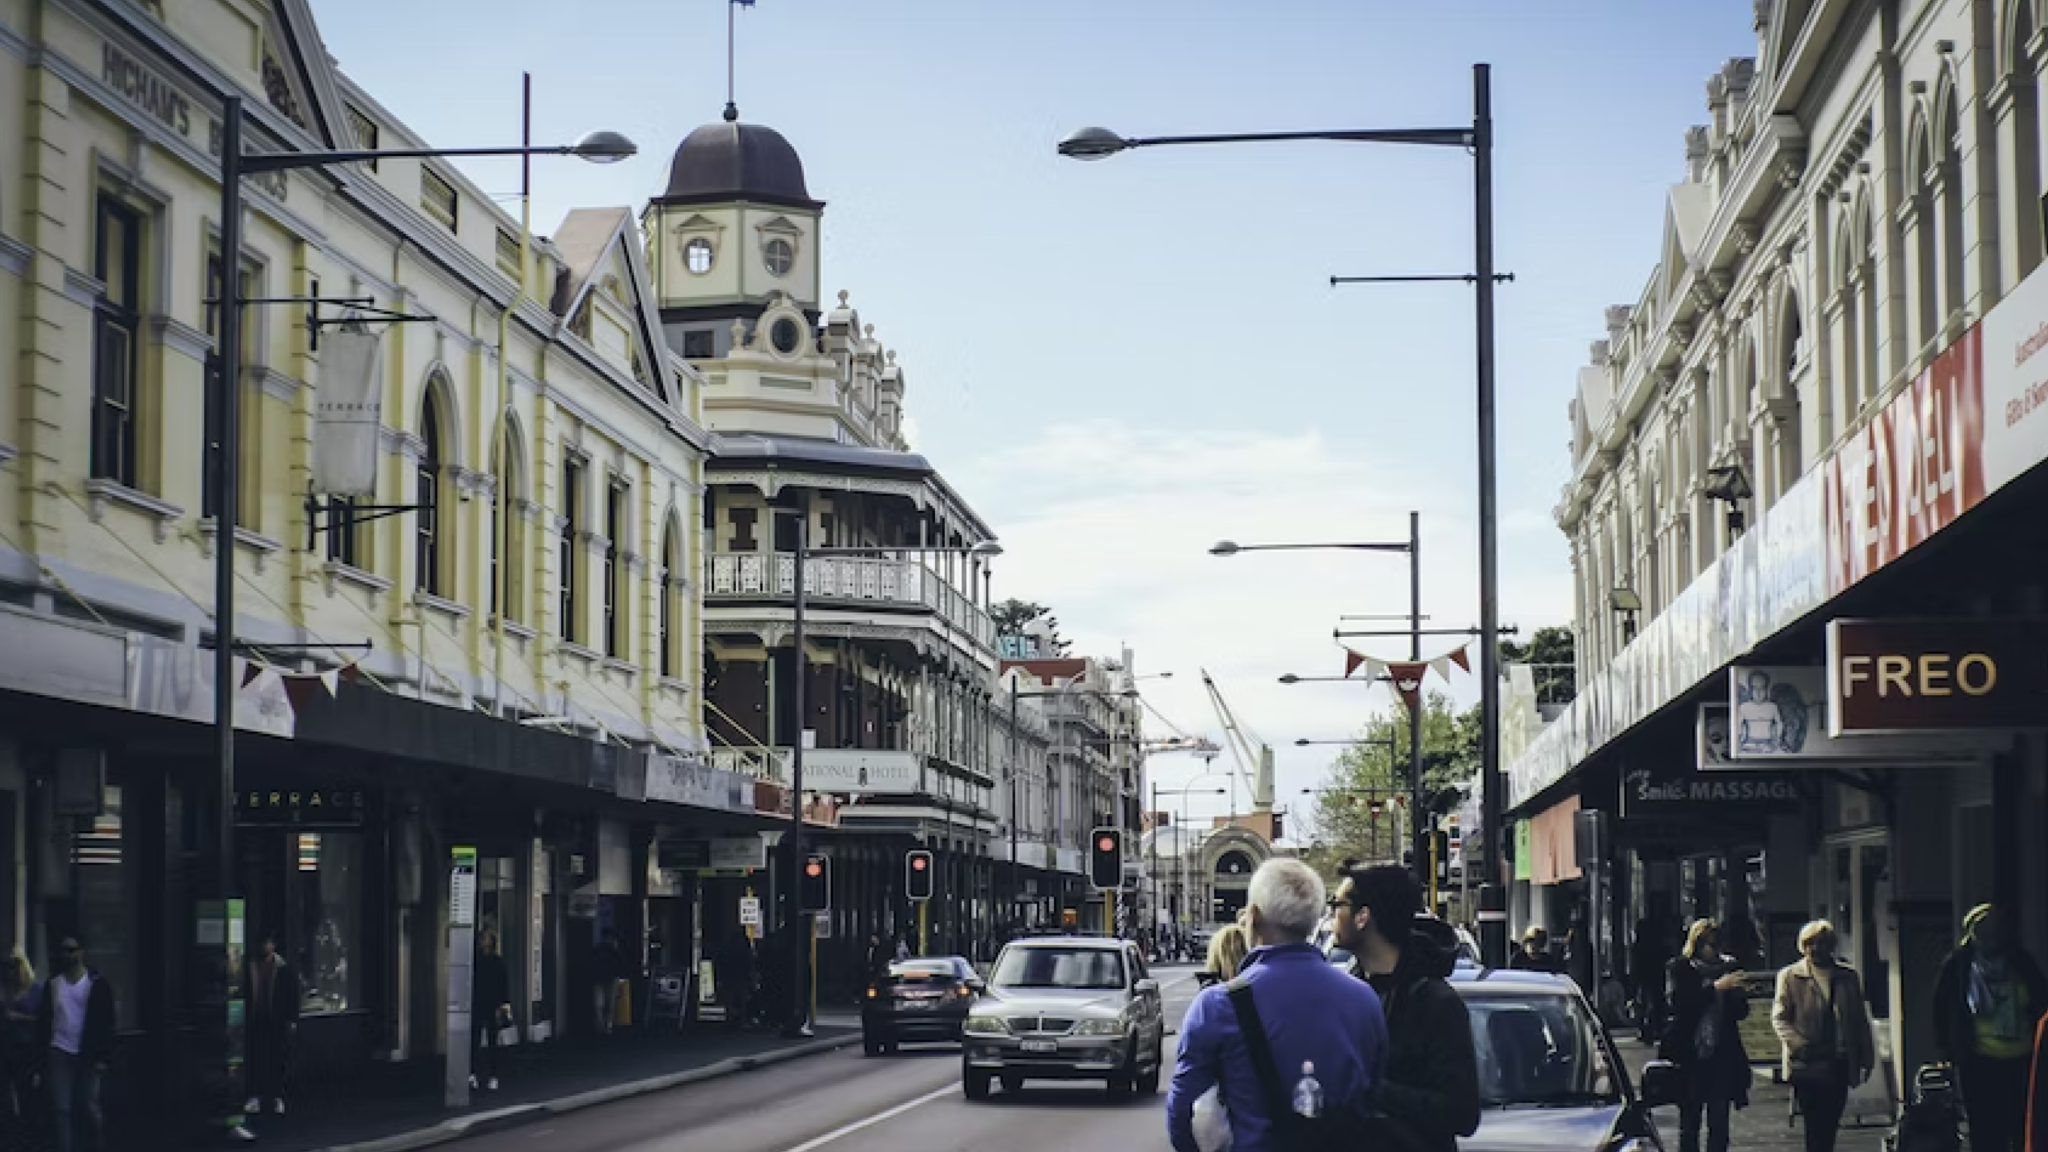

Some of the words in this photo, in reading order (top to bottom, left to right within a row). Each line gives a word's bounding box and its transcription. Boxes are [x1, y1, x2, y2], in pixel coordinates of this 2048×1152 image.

[318, 403, 380, 412] TERRACE
[1843, 653, 1997, 698] FREO
[801, 764, 856, 778] ATIONAL
[870, 766, 912, 779] HOTEL
[1690, 781, 1798, 799] MASSAGE
